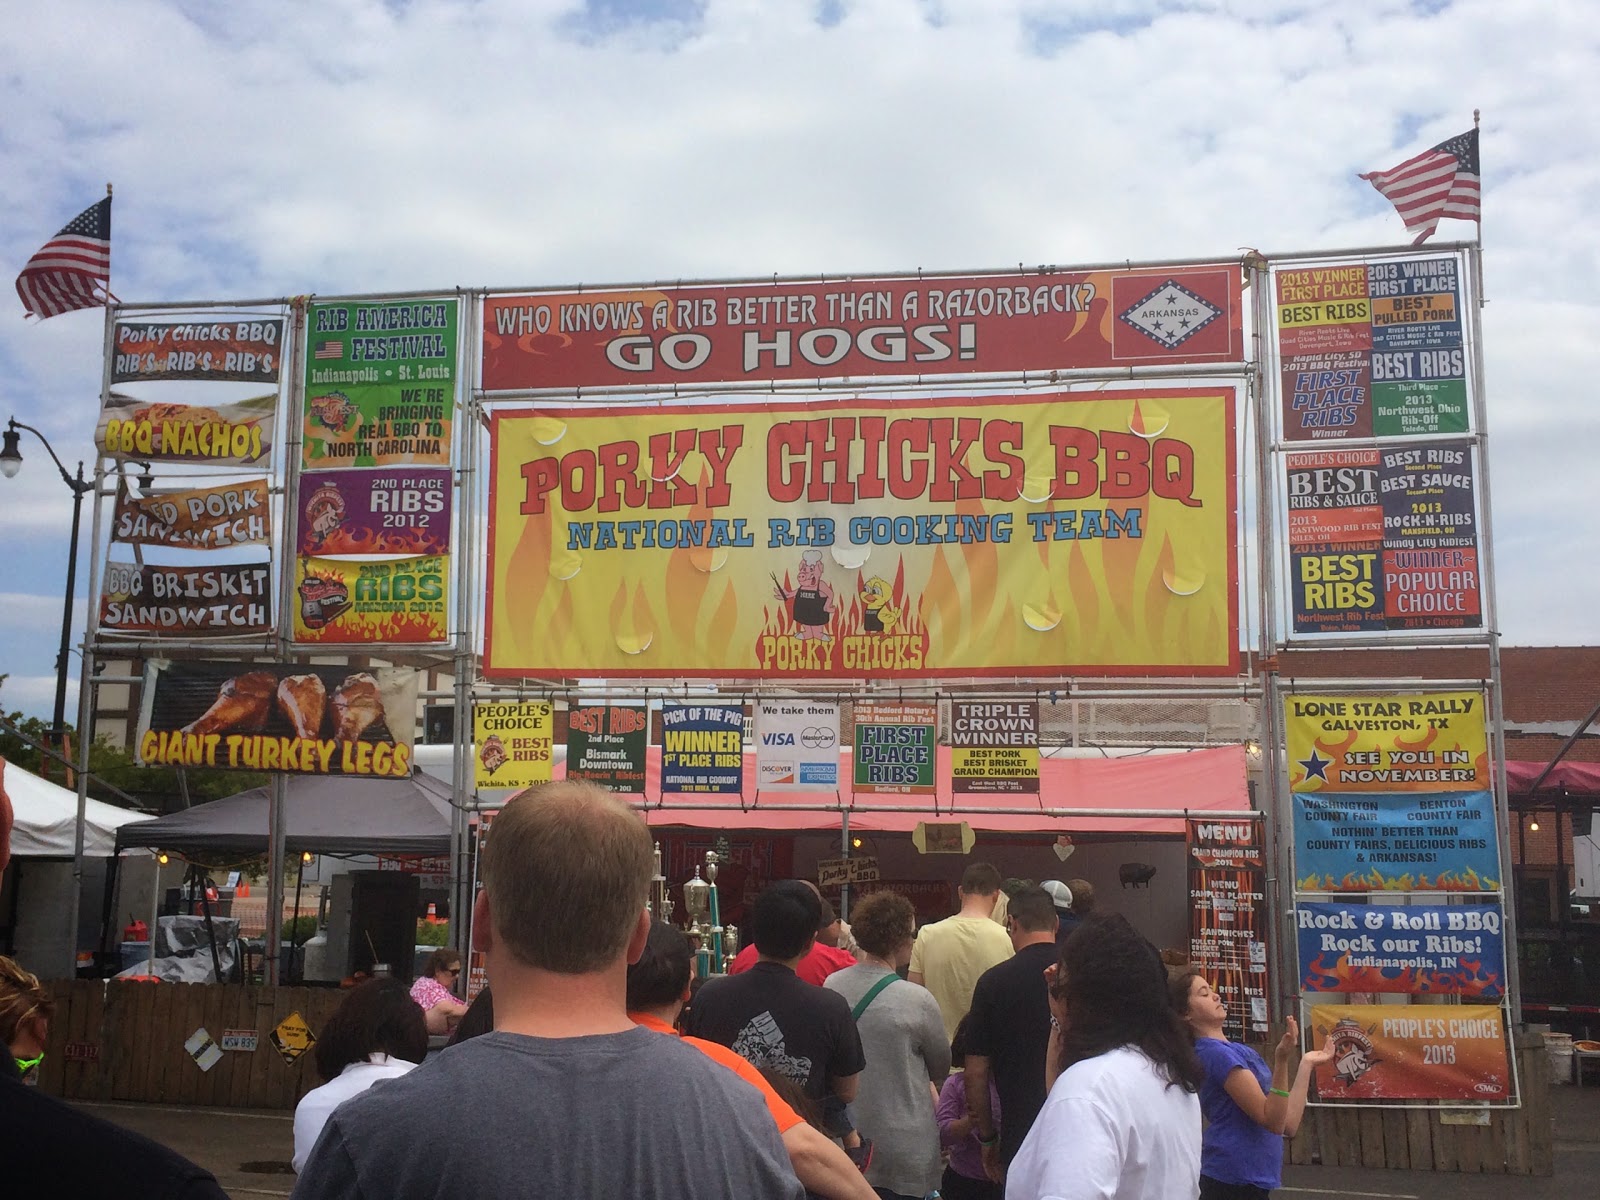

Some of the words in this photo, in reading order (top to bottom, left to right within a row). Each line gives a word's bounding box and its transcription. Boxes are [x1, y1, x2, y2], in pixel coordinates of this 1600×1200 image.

[495, 305, 551, 336] WHO
[559, 301, 644, 332] KNOWS
[652, 300, 668, 331] A
[677, 299, 717, 329] RIB
[727, 295, 817, 325] BETTER
[826, 291, 892, 323] THAN
[902, 290, 918, 321] A
[928, 283, 1096, 320] RAZORBACK?
[1393, 297, 1434, 311] BEST
[316, 308, 349, 331] RIB
[356, 305, 447, 330] AMERICA
[1282, 305, 1321, 324] BEST
[1326, 303, 1367, 320] RIBS
[119, 325, 167, 345] Porky
[171, 323, 231, 343] Chicks
[235, 323, 276, 346] BBQ
[351, 335, 446, 361] FESTIVAL
[605, 333, 712, 372] GO
[743, 323, 977, 373] HOGS!
[1282, 363, 1306, 372] 2013
[1310, 361, 1330, 370] BBQ
[1372, 352, 1415, 380] BEST
[1419, 350, 1463, 377] RIBS
[1294, 369, 1362, 392] FIRST
[1292, 387, 1365, 410] PLACE
[1405, 395, 1433, 405] 2013
[379, 406, 443, 420] BRINGING
[1301, 406, 1358, 428] RIBS
[1378, 407, 1434, 416] Northwest
[1438, 404, 1461, 414] Ohio
[1401, 415, 1439, 426] Rib-Off
[358, 425, 390, 440] REAL
[393, 423, 420, 438] BBQ
[425, 423, 442, 437] TO
[1311, 429, 1348, 438] Winner
[105, 419, 153, 454] BBQ
[161, 421, 263, 460] NACHOS
[327, 442, 372, 457] NORTH
[377, 439, 440, 455] CAROLINA
[520, 424, 744, 515] PORKY
[767, 416, 1025, 503] CHICKS
[1049, 425, 1203, 507] BBQ
[372, 479, 397, 489] 2ND
[402, 479, 444, 489] PLACE
[1289, 468, 1379, 496] BEST
[187, 489, 260, 522] PORK
[370, 490, 444, 512] RIBS
[383, 514, 430, 527] 2012
[1291, 516, 1318, 525] 2013
[567, 519, 754, 550] NATIONAL
[767, 517, 836, 547] RIB
[849, 513, 1013, 545] COOKING
[1027, 509, 1142, 543] TEAM
[1291, 525, 1341, 534] EASTWOOD
[1343, 524, 1359, 532] RIB
[1300, 554, 1376, 583] BEST
[109, 568, 143, 596] BBQ
[152, 570, 267, 598] BRISKET
[355, 575, 443, 600] RIBS
[1386, 571, 1476, 592] POPULAR
[1305, 582, 1376, 610] RIBS
[1398, 592, 1466, 612] CHOICE
[105, 602, 265, 627] SANDWICH
[354, 602, 405, 613] ARIZONA
[409, 602, 443, 613] 2012
[1297, 613, 1344, 623] Northwest
[1347, 612, 1362, 621] Rib
[1365, 612, 1384, 621] Fest
[763, 635, 835, 670] PORKY
[842, 635, 923, 670] CHICKS
[477, 705, 550, 718] PEOPLE'S
[781, 706, 804, 714] take
[807, 706, 834, 714] them
[959, 705, 1030, 717] TRIPLE
[1294, 702, 1346, 717] LONE
[1353, 702, 1401, 717] STAR
[1409, 699, 1474, 715] RALLY
[484, 718, 542, 730] CHOICE
[569, 707, 605, 733] BEST
[609, 707, 646, 734] RIBS
[663, 710, 687, 725] PICK
[689, 708, 701, 720] OF
[704, 708, 722, 721] THE
[724, 711, 742, 726] PIG
[955, 719, 1034, 731] CROWN
[588, 735, 602, 743] 2nd
[604, 735, 624, 743] Place
[665, 731, 741, 752] WINNER
[762, 733, 795, 746] VISA
[863, 726, 926, 745] FIRST
[953, 732, 1038, 745] WINNER
[512, 738, 551, 748] BEST
[141, 729, 221, 767] GIANT
[227, 735, 336, 773] TURKEY
[341, 741, 410, 777] LEGS
[513, 750, 549, 761] RIBS
[586, 749, 627, 760] Bismark
[860, 745, 928, 764] PLACE
[969, 750, 993, 758] BEST
[995, 750, 1021, 758] PORK
[579, 759, 633, 769] Downtown
[964, 759, 987, 767] BEST
[989, 759, 1028, 767] BRISKET
[868, 765, 919, 784] RIBS
[953, 768, 985, 776] GRAND
[987, 768, 1038, 776] CHAMPION
[1340, 768, 1476, 783] NOVEMBER!
[666, 776, 694, 784] NATIONAL
[696, 775, 708, 783] RIB
[709, 775, 737, 784] COOKOFF
[1302, 800, 1379, 811] WASHINGTON
[1419, 799, 1466, 810] BENTON
[1305, 812, 1349, 821] COUNTY
[1352, 812, 1378, 821] FAIR
[1407, 811, 1452, 821] COUNTY
[1456, 810, 1482, 820] FAIR
[1197, 825, 1251, 840] MENU
[1331, 827, 1378, 837] NOTHIN'
[1381, 827, 1424, 836] BETTER
[1427, 826, 1458, 836] THAN
[1306, 840, 1351, 850] COUNTY
[1354, 840, 1391, 851] FAIRS,
[1394, 840, 1456, 849] DELICIOUS
[1459, 839, 1486, 849] RIBS
[1356, 853, 1365, 862] &
[1369, 853, 1437, 862] ARKANSAS!
[822, 867, 848, 883] Porky
[856, 871, 875, 880] BBQ
[1211, 881, 1239, 889] MENU
[1191, 890, 1224, 898] SAMPLER
[1228, 892, 1263, 900] PLATTER
[1298, 909, 1358, 930] Rock
[1364, 912, 1385, 929] &
[1391, 912, 1441, 931] Roll
[1447, 911, 1500, 935] BBQ
[1200, 928, 1254, 938] SANDWICHES
[1320, 933, 1375, 952] Rock
[1382, 939, 1420, 952] our
[1425, 935, 1482, 953] Ribs!
[241, 1038, 255, 1046] 839
[1423, 1045, 1456, 1064] 2013
